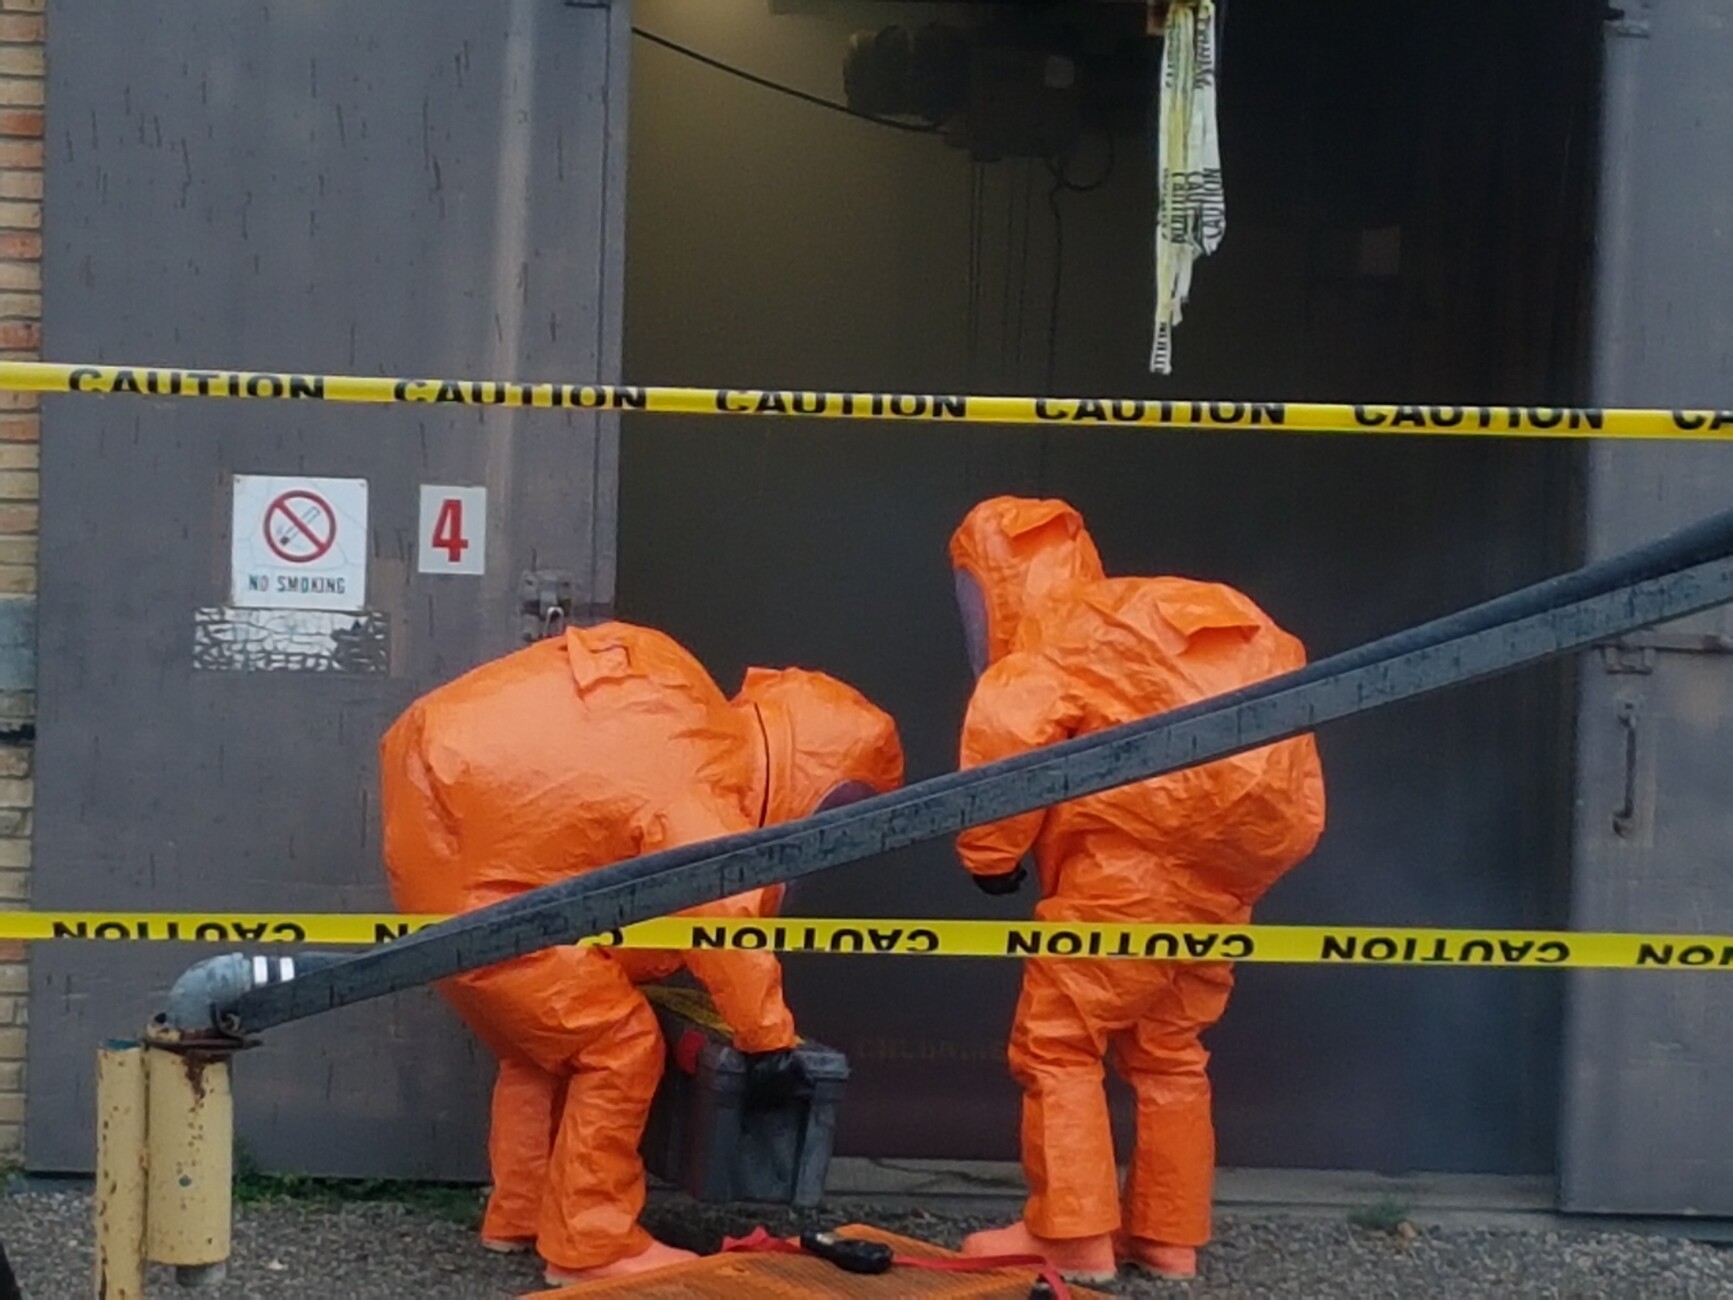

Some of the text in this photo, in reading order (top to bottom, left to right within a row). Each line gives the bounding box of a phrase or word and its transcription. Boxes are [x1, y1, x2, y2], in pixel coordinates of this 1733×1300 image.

[69, 370, 324, 399] CAUTION
[394, 379, 647, 409] CAUTION
[715, 390, 967, 418] CAUTION
[1035, 398, 1286, 425] CAUTION
[1354, 405, 1604, 430] CAUTION
[432, 499, 469, 562] 4
[249, 575, 346, 594] NO SMOKING
[52, 921, 306, 943] CAUTION
[692, 925, 940, 952] CAUTION
[1006, 930, 1255, 958] CAUTION
[1321, 935, 1571, 962] CAUTION
